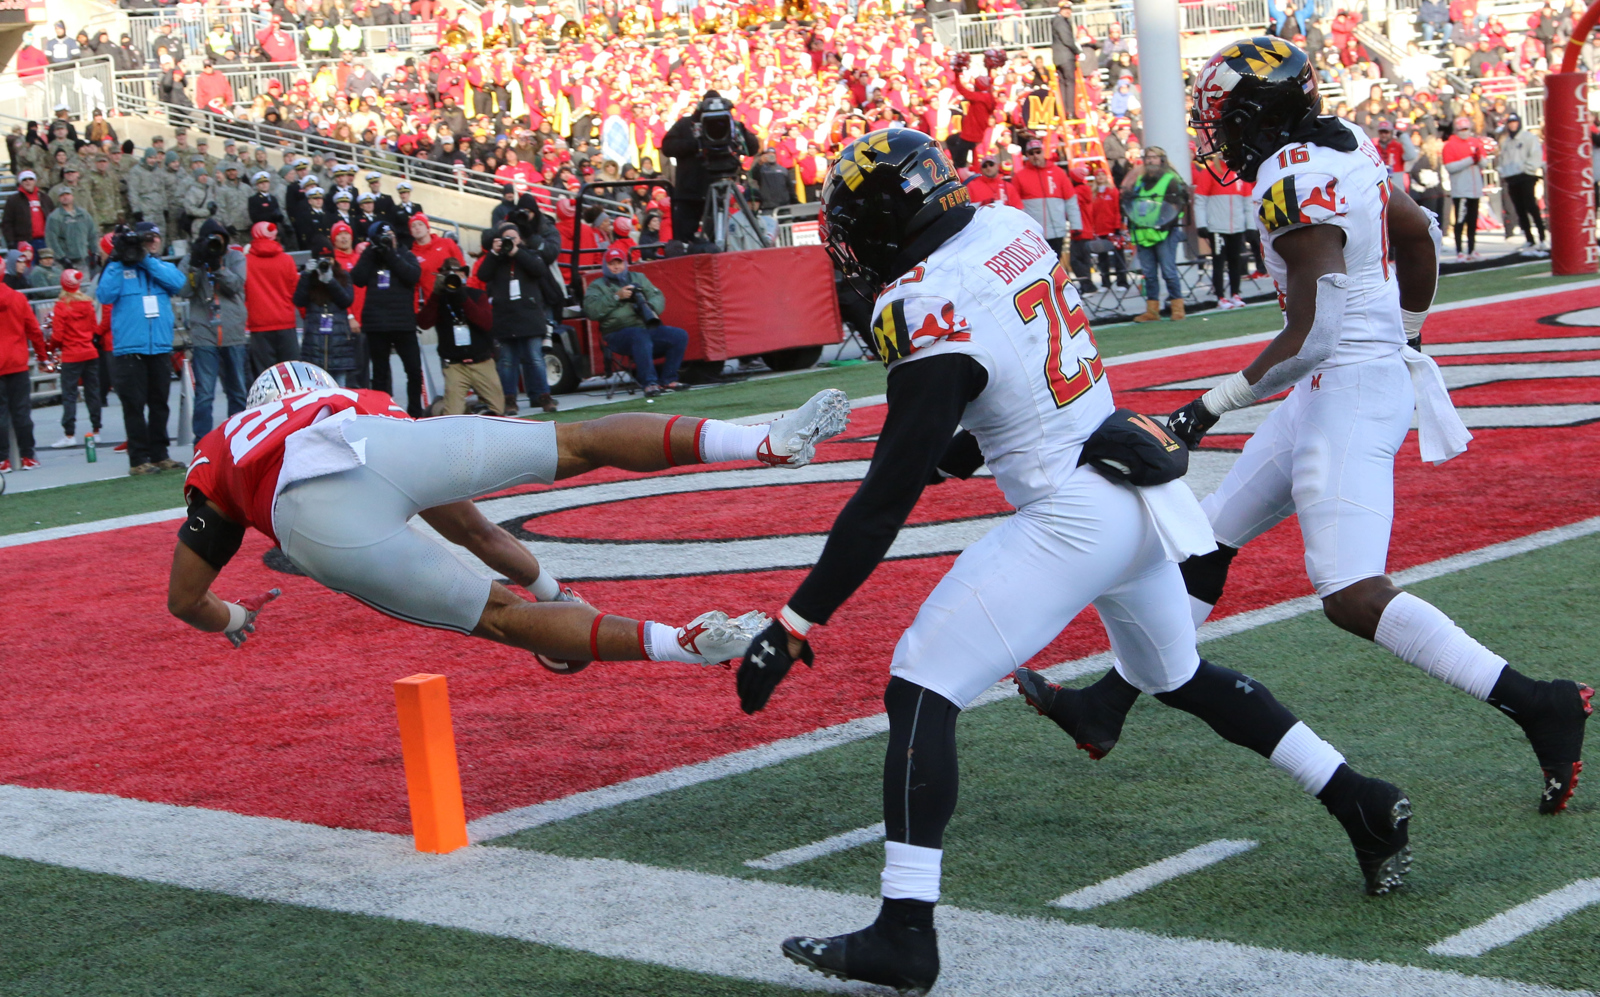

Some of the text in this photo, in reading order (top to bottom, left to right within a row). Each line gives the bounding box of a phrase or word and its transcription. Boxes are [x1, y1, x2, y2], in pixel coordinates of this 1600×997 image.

[1028, 95, 1056, 129] M
[1276, 144, 1310, 170] 16
[939, 186, 970, 212] TERPS
[1580, 167, 1600, 264] STATE
[983, 237, 1042, 285] BROOKS
[1013, 260, 1105, 409] 25
[1127, 413, 1176, 447] M
